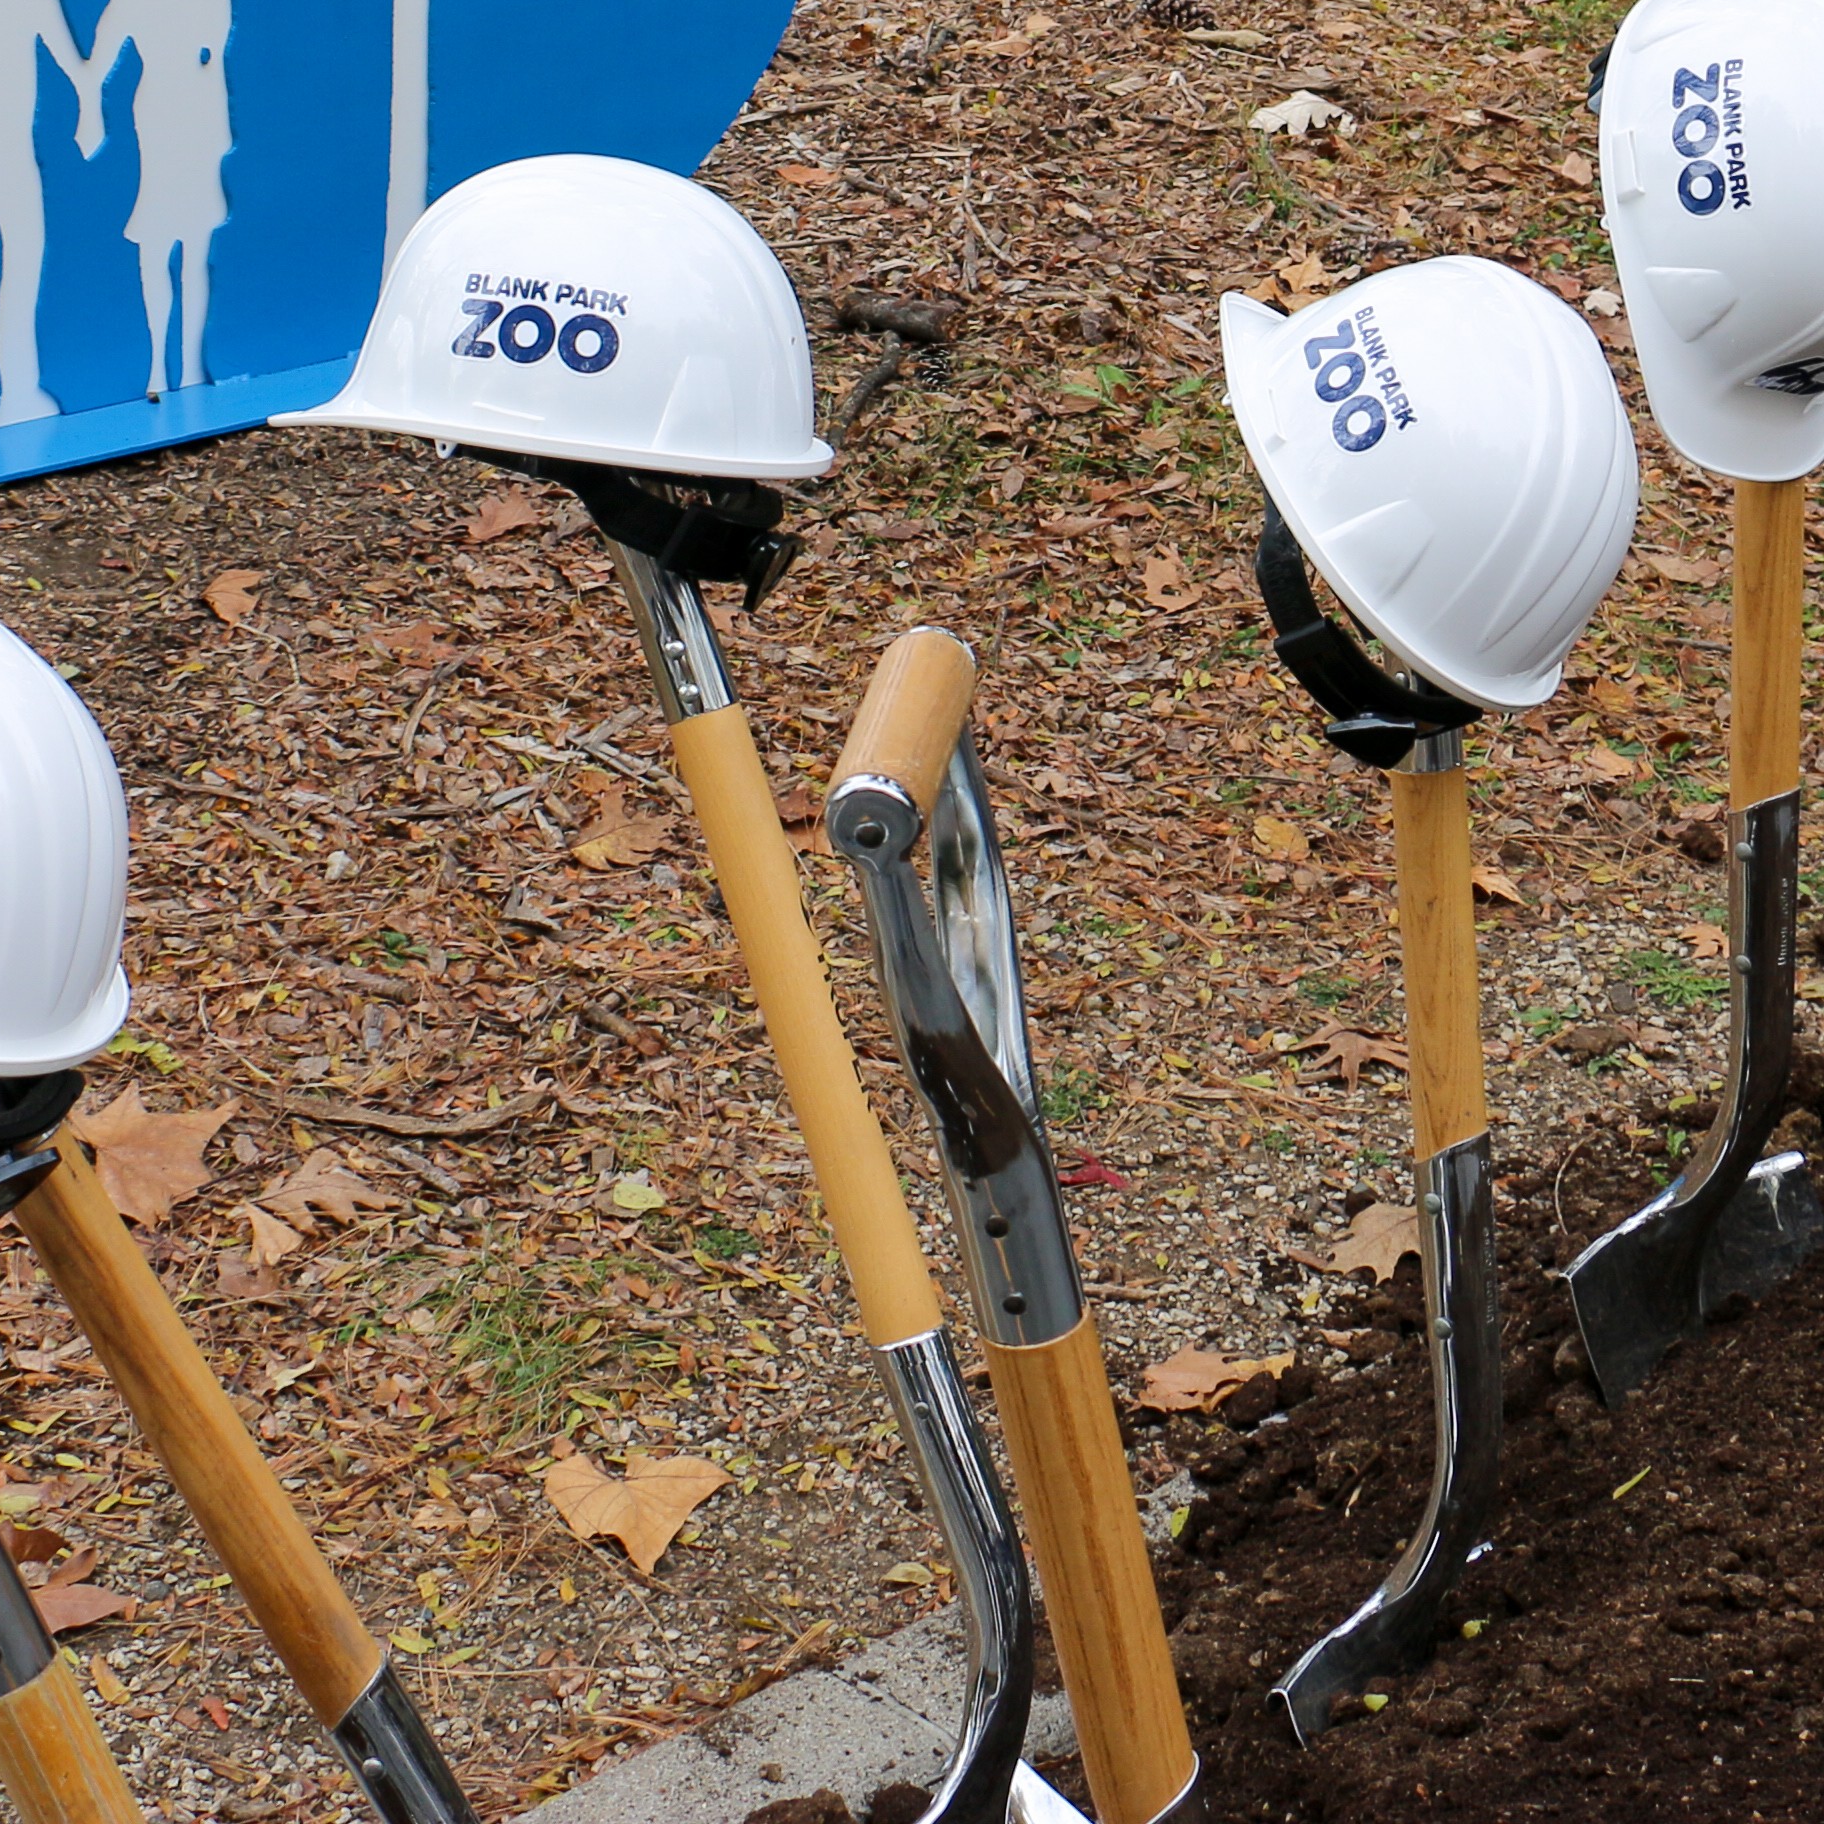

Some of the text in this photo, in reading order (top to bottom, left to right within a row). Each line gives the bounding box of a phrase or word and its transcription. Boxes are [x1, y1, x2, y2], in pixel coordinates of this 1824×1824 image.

[1672, 63, 1726, 215] ZOO
[1723, 59, 1751, 210] BLANK PARK
[452, 298, 619, 374] ZOO
[465, 274, 628, 315] BLANK PARK
[1303, 318, 1387, 452] ZOO
[1355, 306, 1418, 430] BLANK PARK
